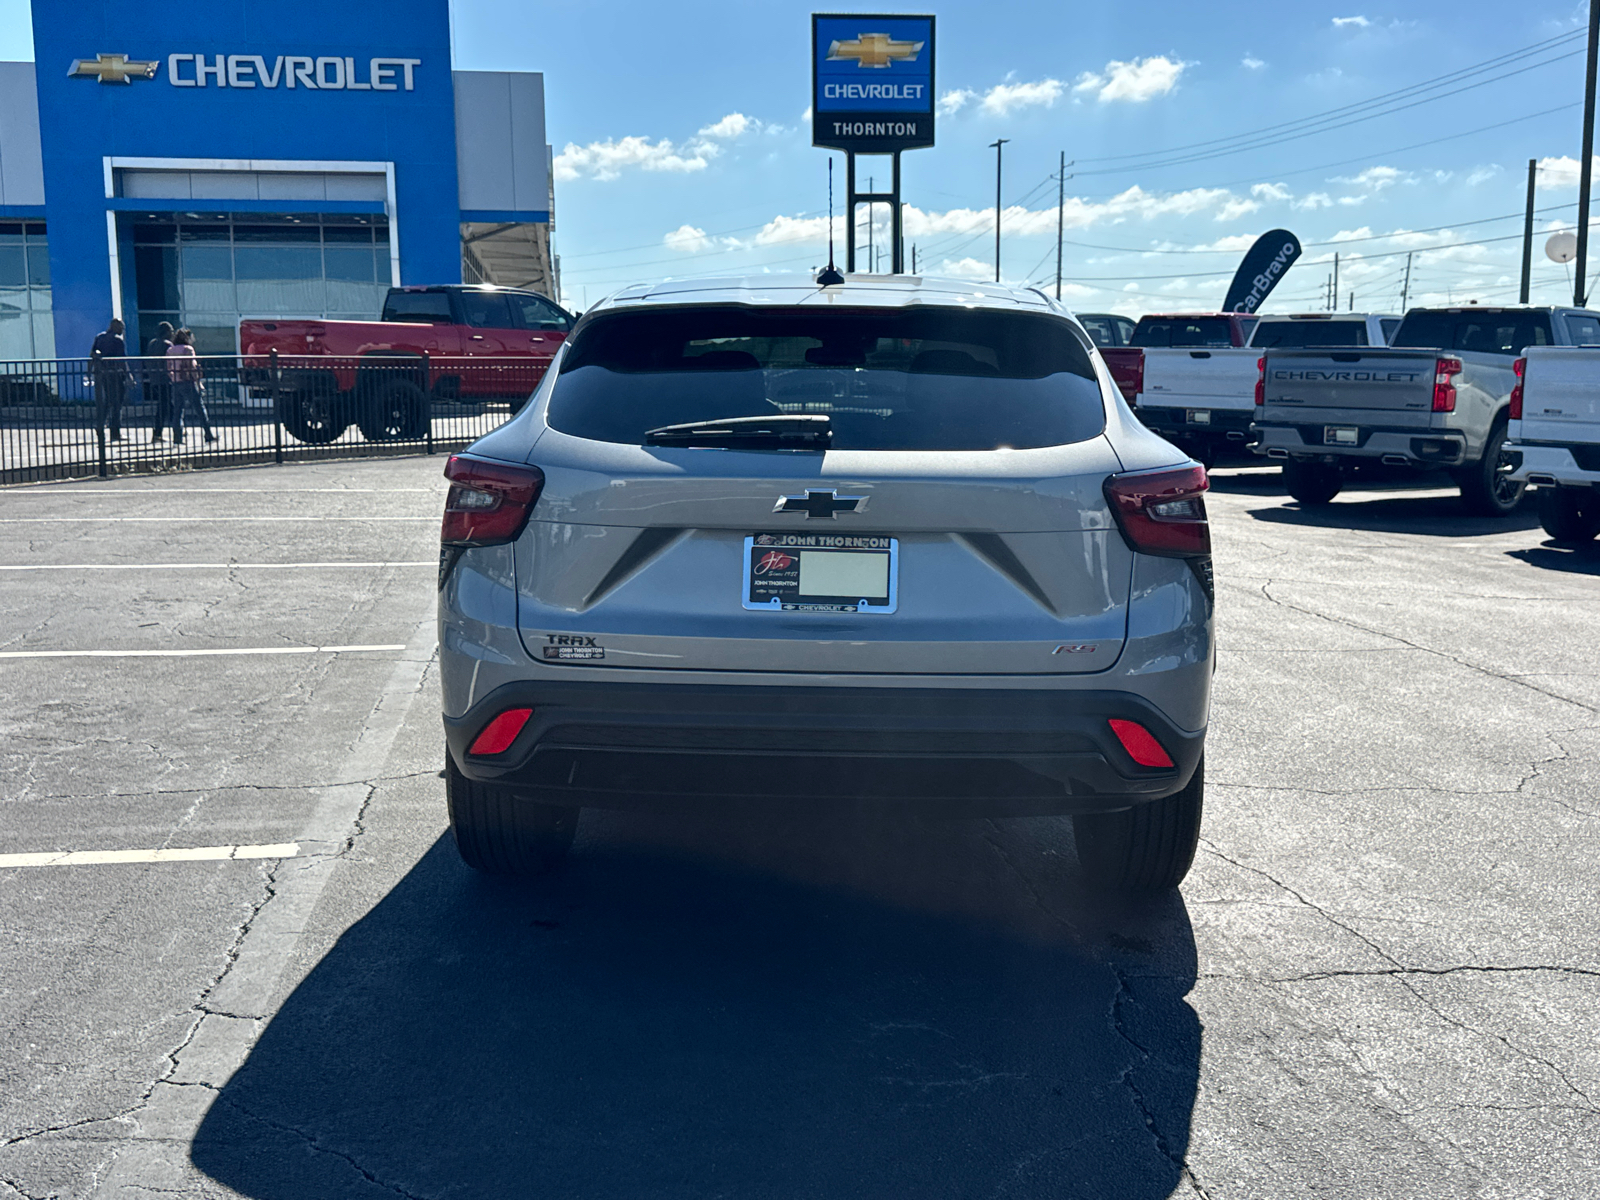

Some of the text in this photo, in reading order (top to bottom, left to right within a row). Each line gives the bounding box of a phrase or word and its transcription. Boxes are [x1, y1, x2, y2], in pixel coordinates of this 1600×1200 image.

[168, 53, 421, 90] CHEVROLET
[824, 84, 924, 99] CHEVROLET
[833, 122, 916, 136] THORNTON
[1233, 242, 1294, 313] CarBravo
[1274, 370, 1420, 382] CHEVROLET
[780, 535, 816, 546] JOHN
[546, 634, 597, 647] TRAX
[1052, 644, 1099, 655] RS
